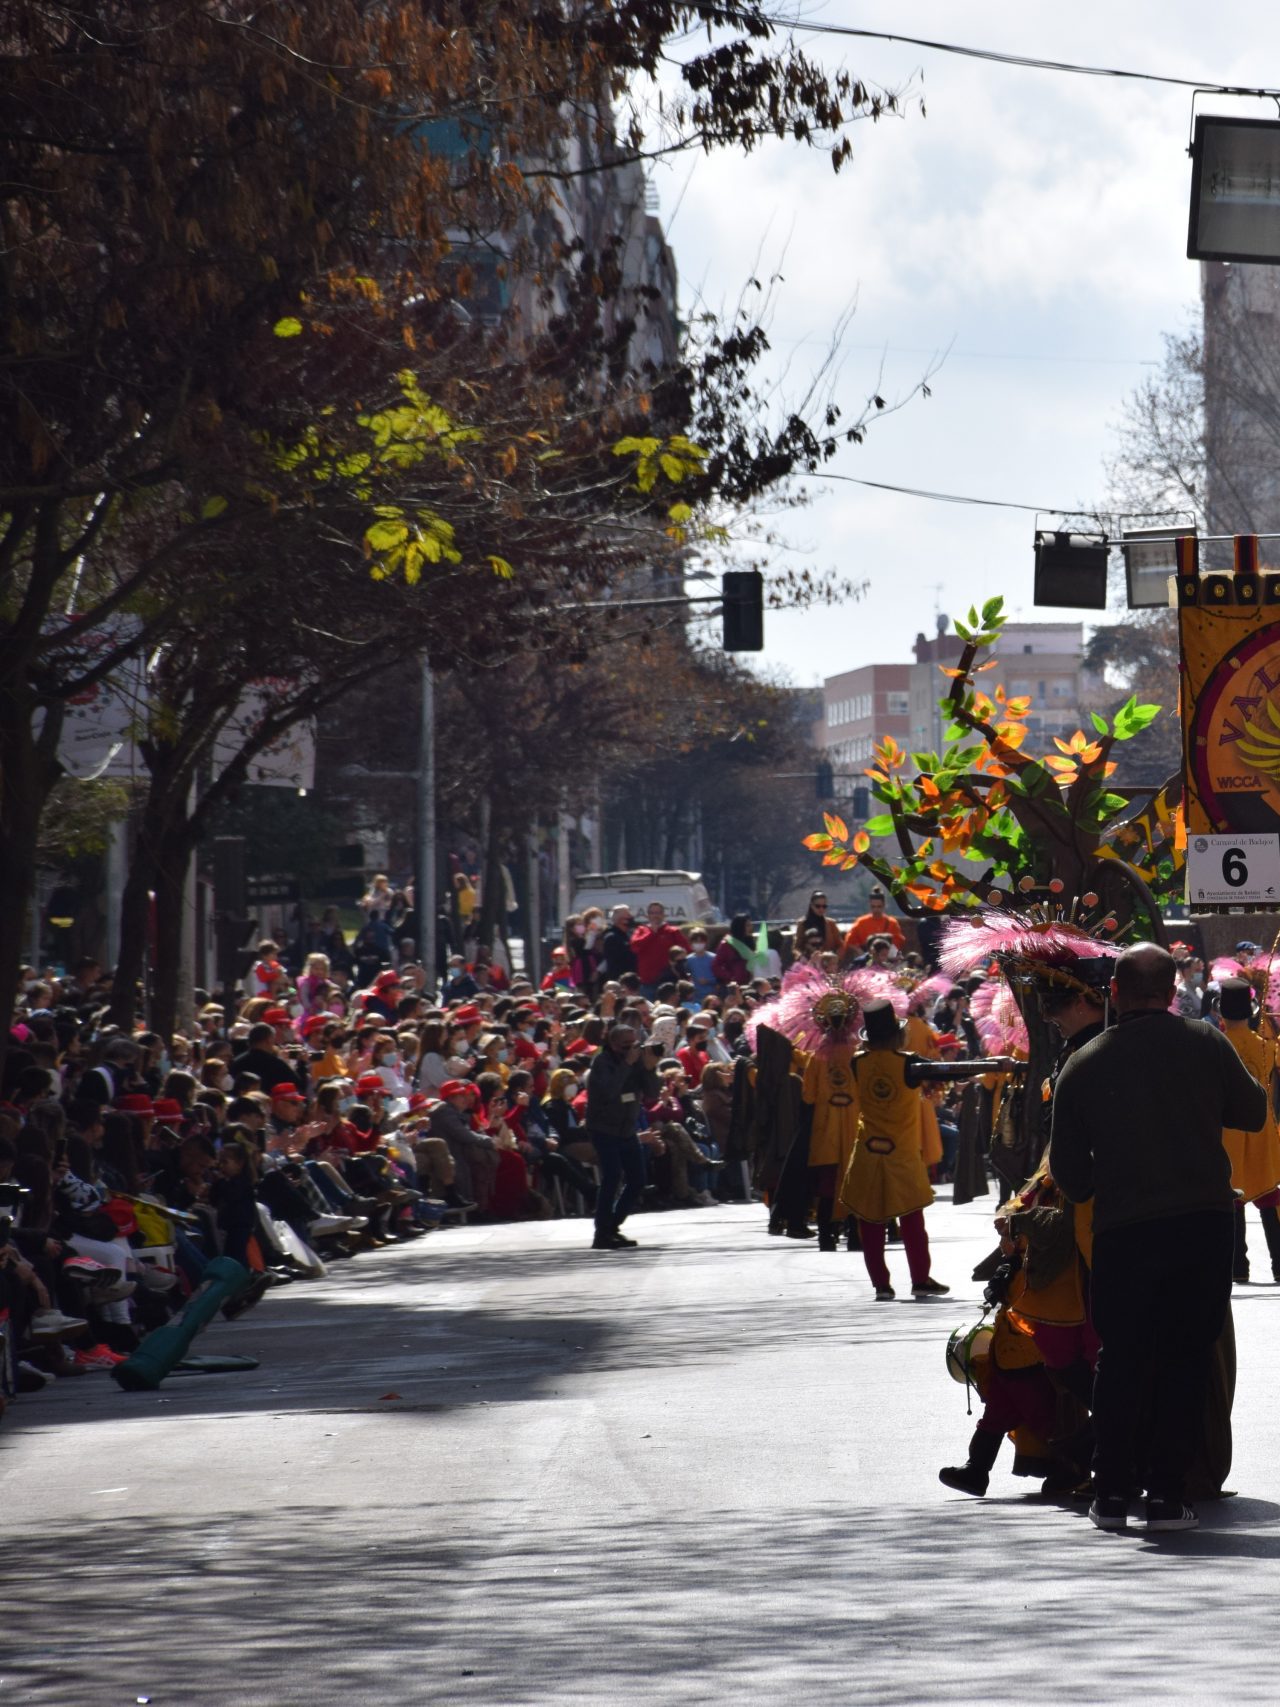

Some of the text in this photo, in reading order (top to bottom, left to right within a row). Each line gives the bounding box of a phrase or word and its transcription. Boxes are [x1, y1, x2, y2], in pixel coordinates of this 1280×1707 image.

[1216, 775, 1262, 789] WICCA
[1211, 838, 1238, 846] Carnaval
[1239, 838, 1247, 846] de
[1249, 838, 1274, 848] Badajoz
[1222, 847, 1248, 887] 6
